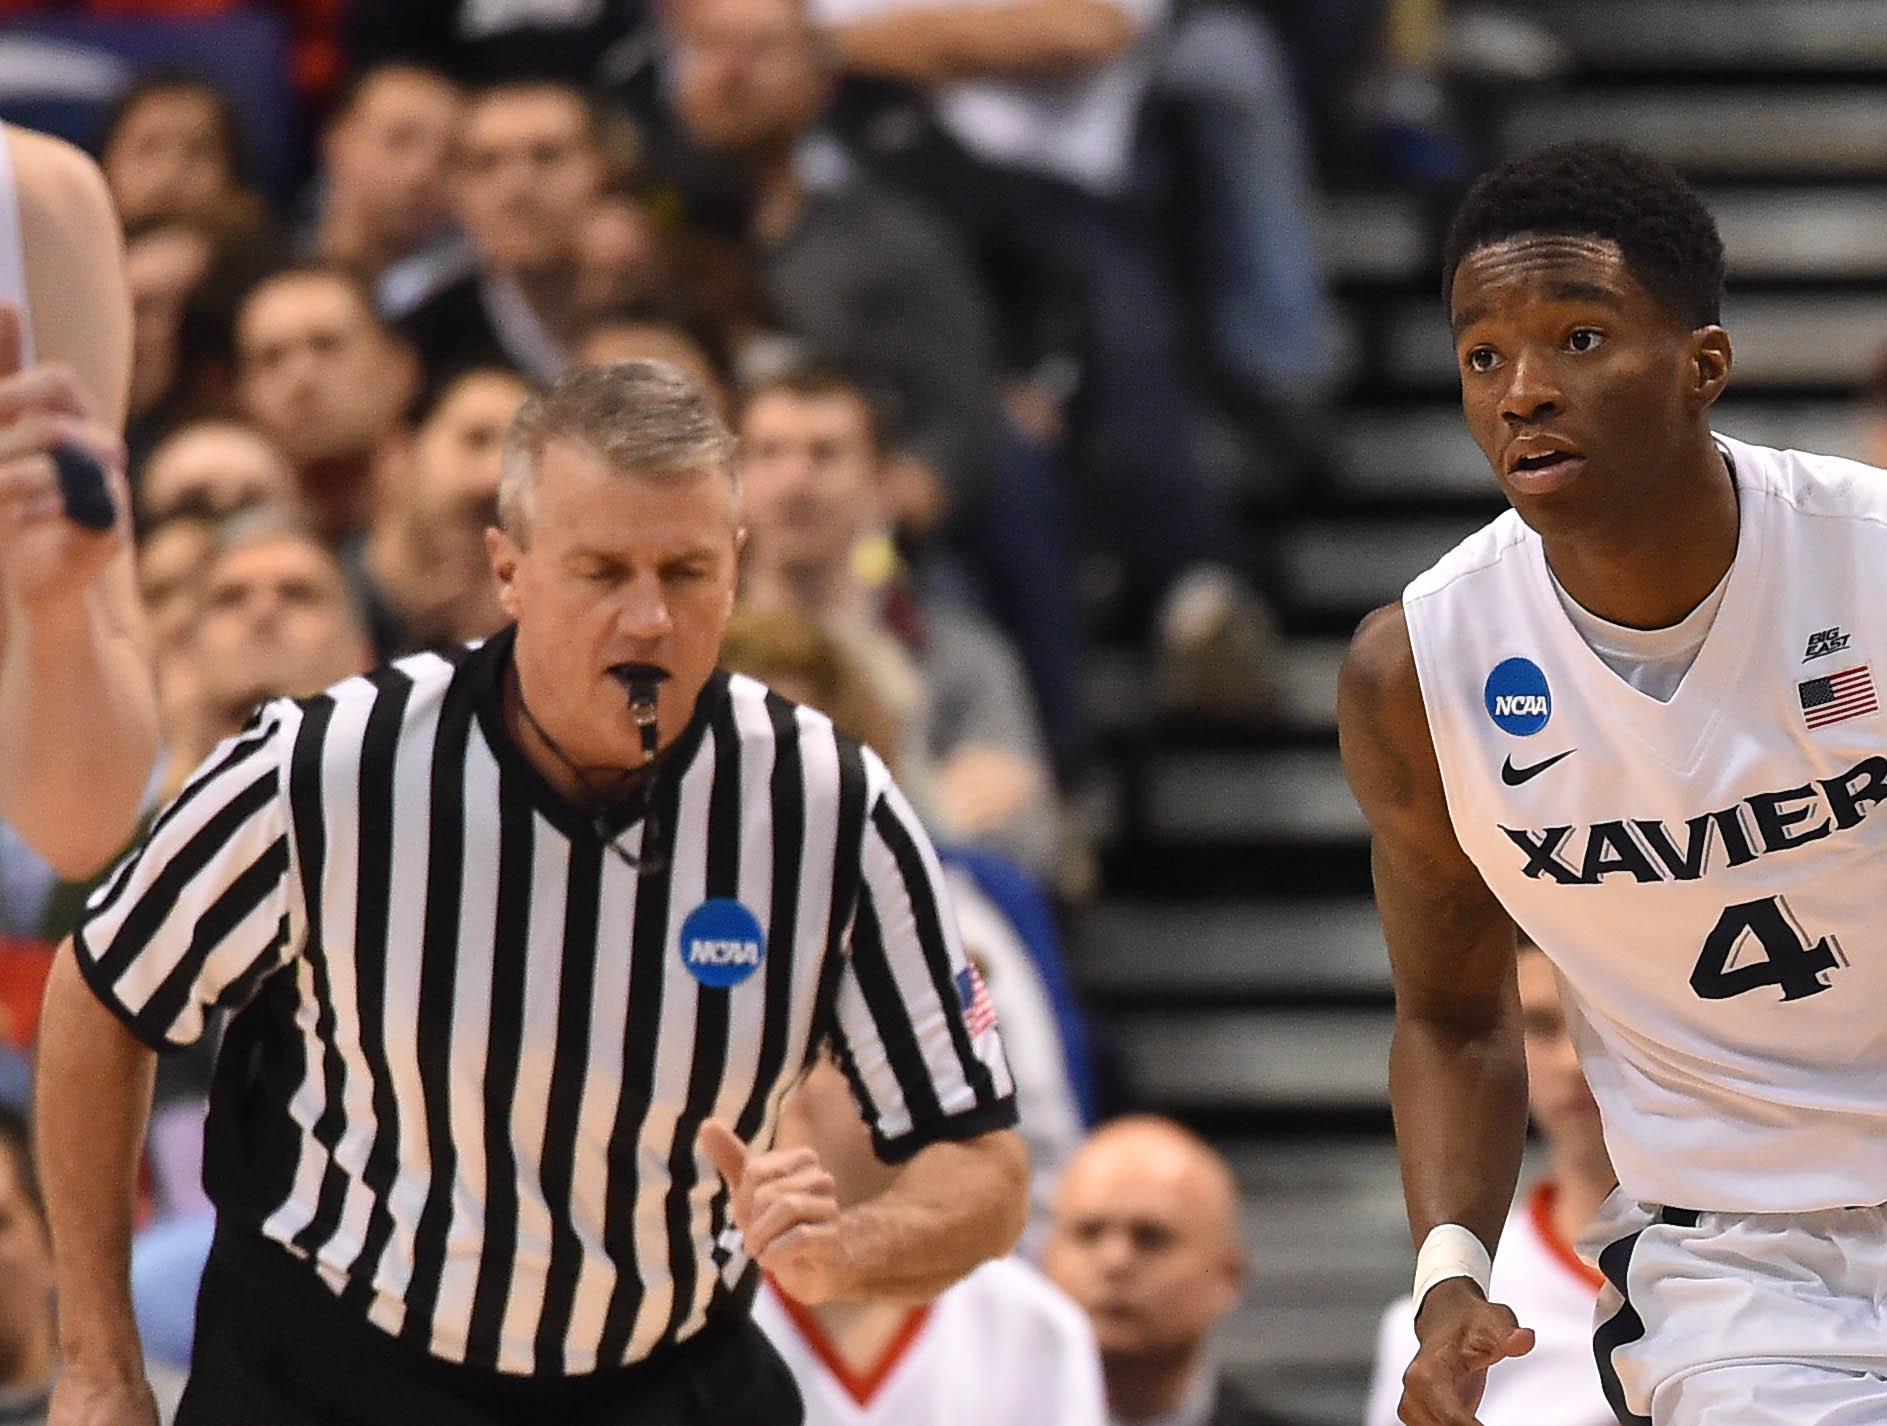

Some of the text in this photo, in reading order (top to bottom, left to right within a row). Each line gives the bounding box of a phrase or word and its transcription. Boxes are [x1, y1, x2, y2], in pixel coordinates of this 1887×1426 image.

[1805, 634, 1851, 656] EAST
[1808, 626, 1840, 645] BIG
[1495, 695, 1548, 716] NCAA
[1688, 895, 1850, 1003] 4
